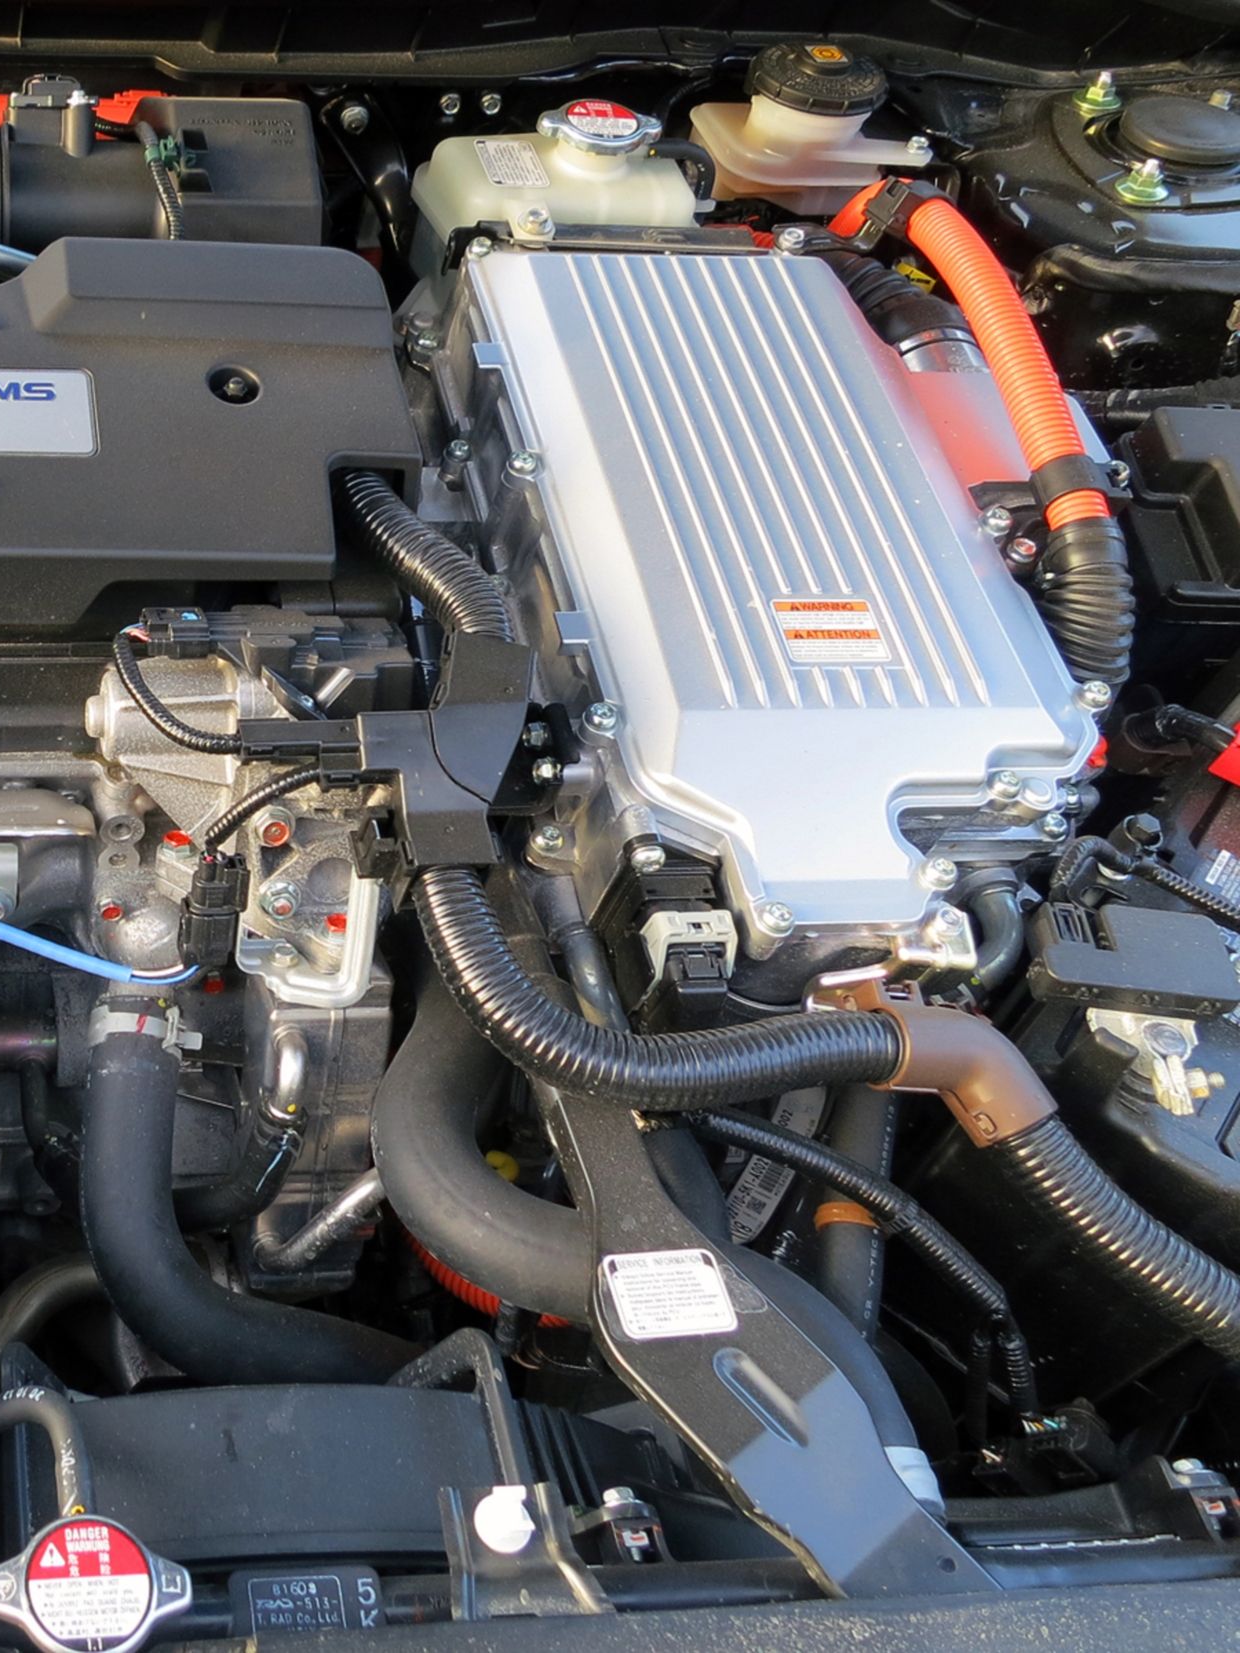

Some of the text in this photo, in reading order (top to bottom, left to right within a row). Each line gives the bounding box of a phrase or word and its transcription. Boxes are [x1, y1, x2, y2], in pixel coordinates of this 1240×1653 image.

[803, 602, 855, 611] WARNING
[806, 630, 871, 639] ATTENTION
[618, 1254, 702, 1269] SERVICE INFORMATION
[64, 1526, 109, 1541] DANGER
[357, 1578, 376, 1606] 5
[270, 1614, 292, 1624] RAD
